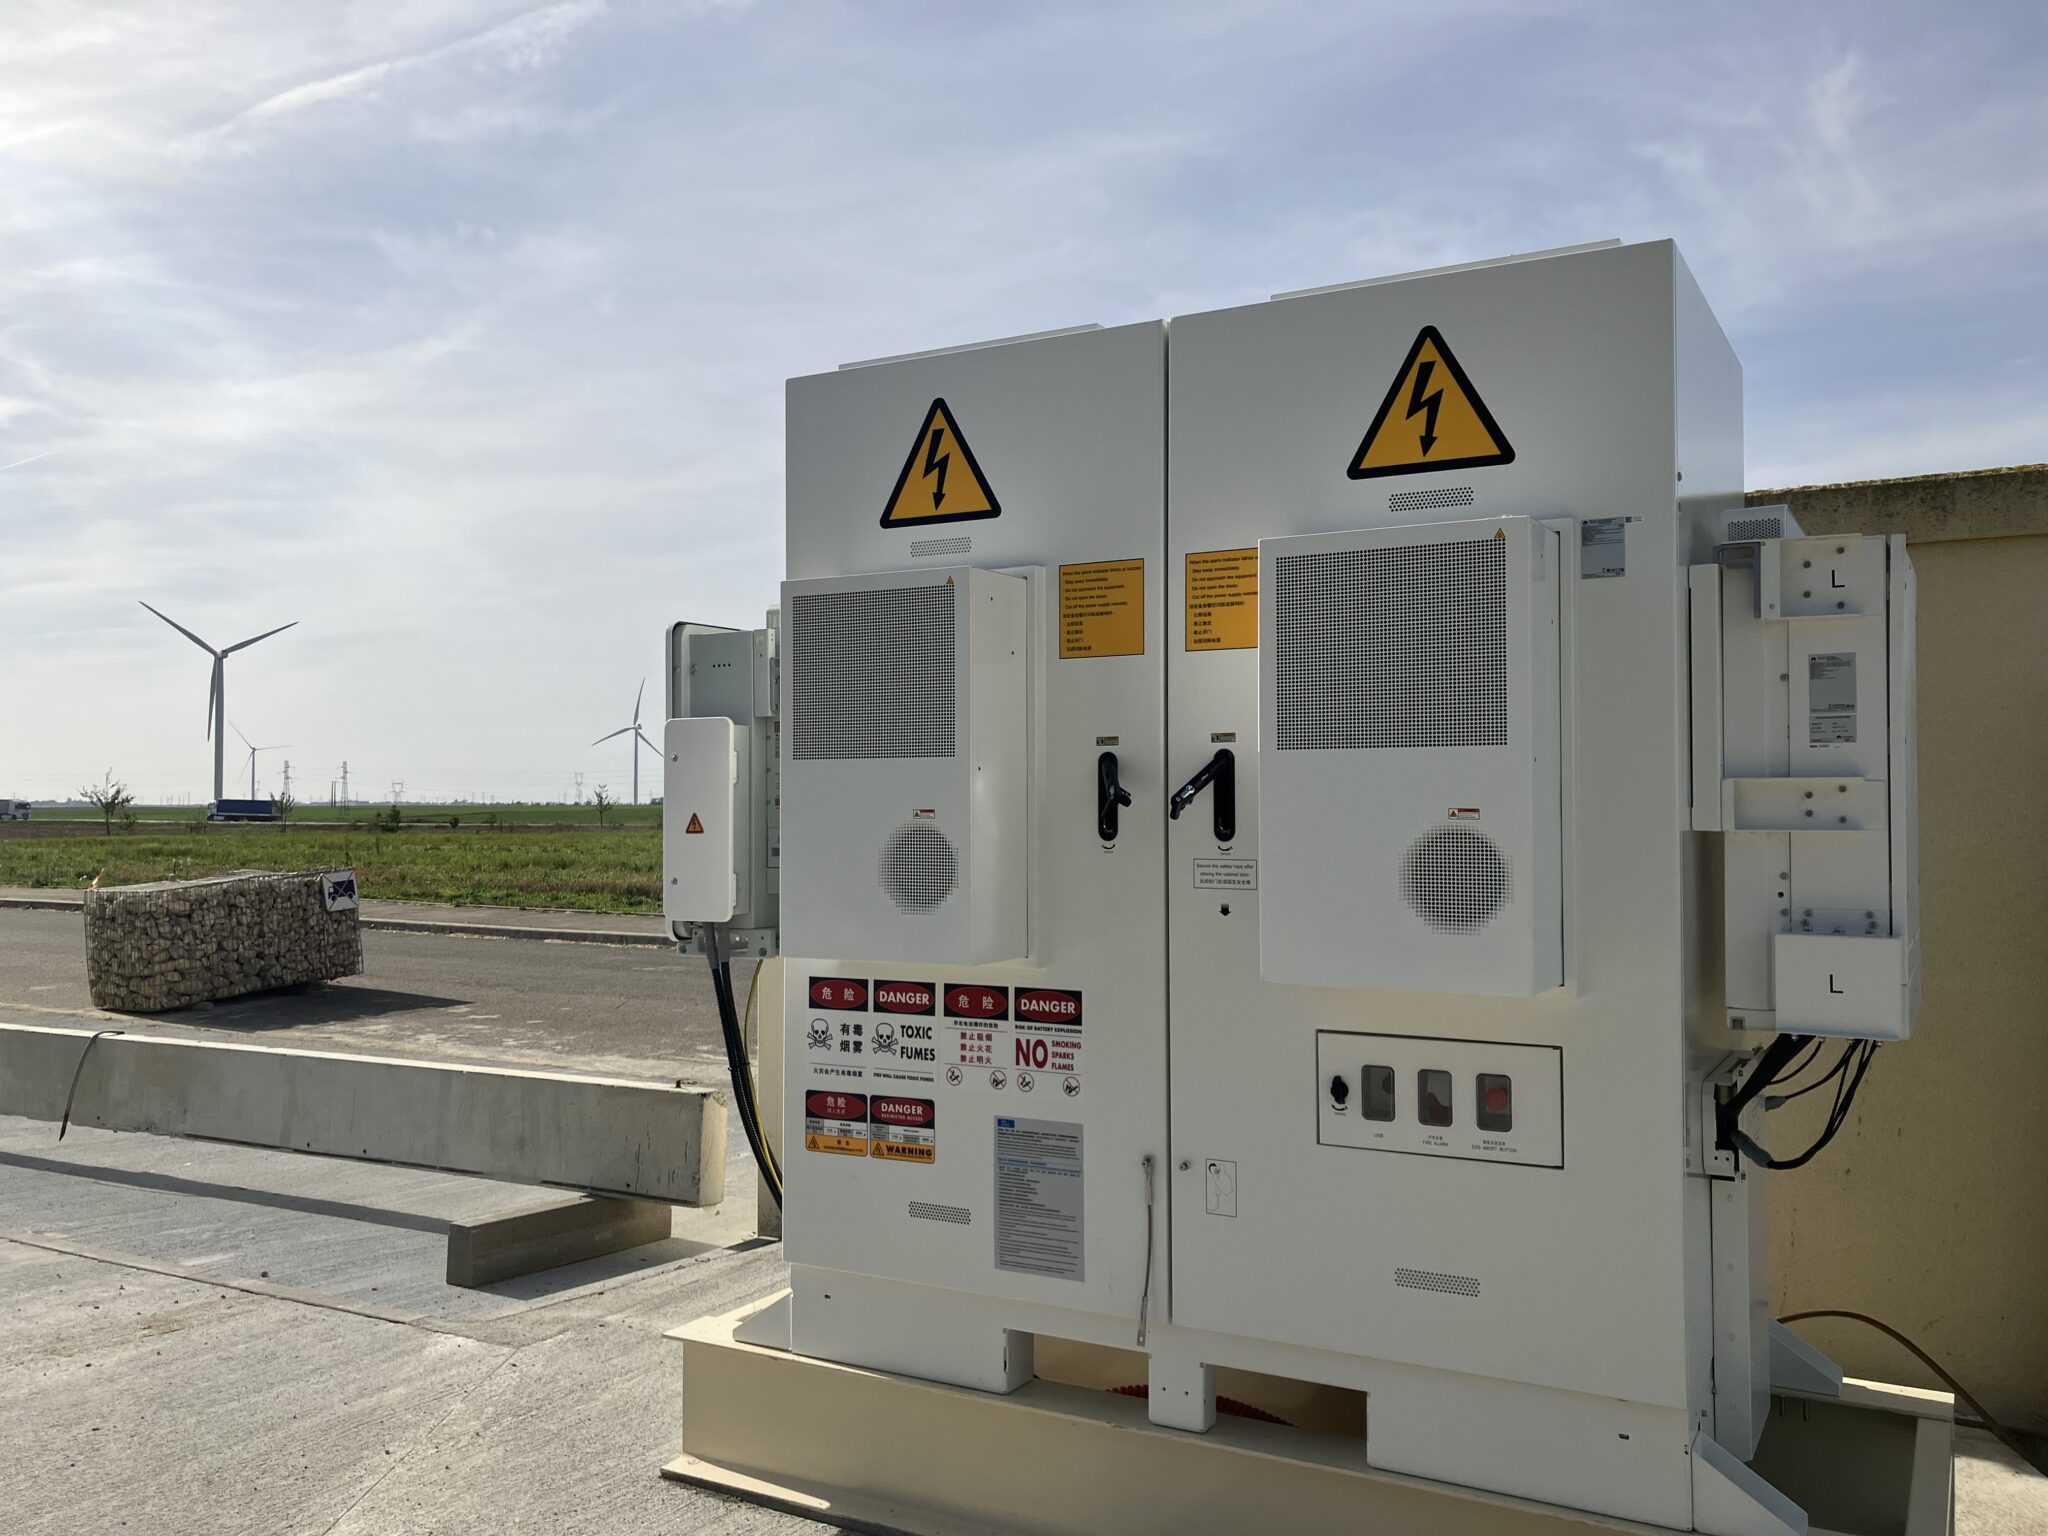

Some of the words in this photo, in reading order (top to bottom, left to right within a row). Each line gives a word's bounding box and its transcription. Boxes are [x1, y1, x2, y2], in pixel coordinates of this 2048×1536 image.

[1832, 569, 1846, 588] L
[1830, 974, 1844, 994] L
[822, 986, 854, 1001] 危险
[879, 991, 929, 1005] DANGER
[958, 994, 994, 1010] 危险
[1020, 998, 1075, 1014] DANGER
[840, 1022, 863, 1037] 有毒
[900, 1025, 932, 1040] TOXIC
[960, 1032, 992, 1042] 禁止吸烟
[840, 1040, 862, 1054] 烟雾
[960, 1043, 992, 1053] 禁止火花
[1051, 1040, 1082, 1049] SMOKING
[900, 1046, 936, 1061] FUMES
[960, 1055, 992, 1065] 禁止明火
[1015, 1038, 1048, 1069] NO
[1051, 1051, 1074, 1060] SPARKS
[1051, 1062, 1074, 1071] FLAMES
[826, 1096, 846, 1108] 危险
[881, 1102, 923, 1115] DANGER
[886, 1144, 932, 1157] WARNING
